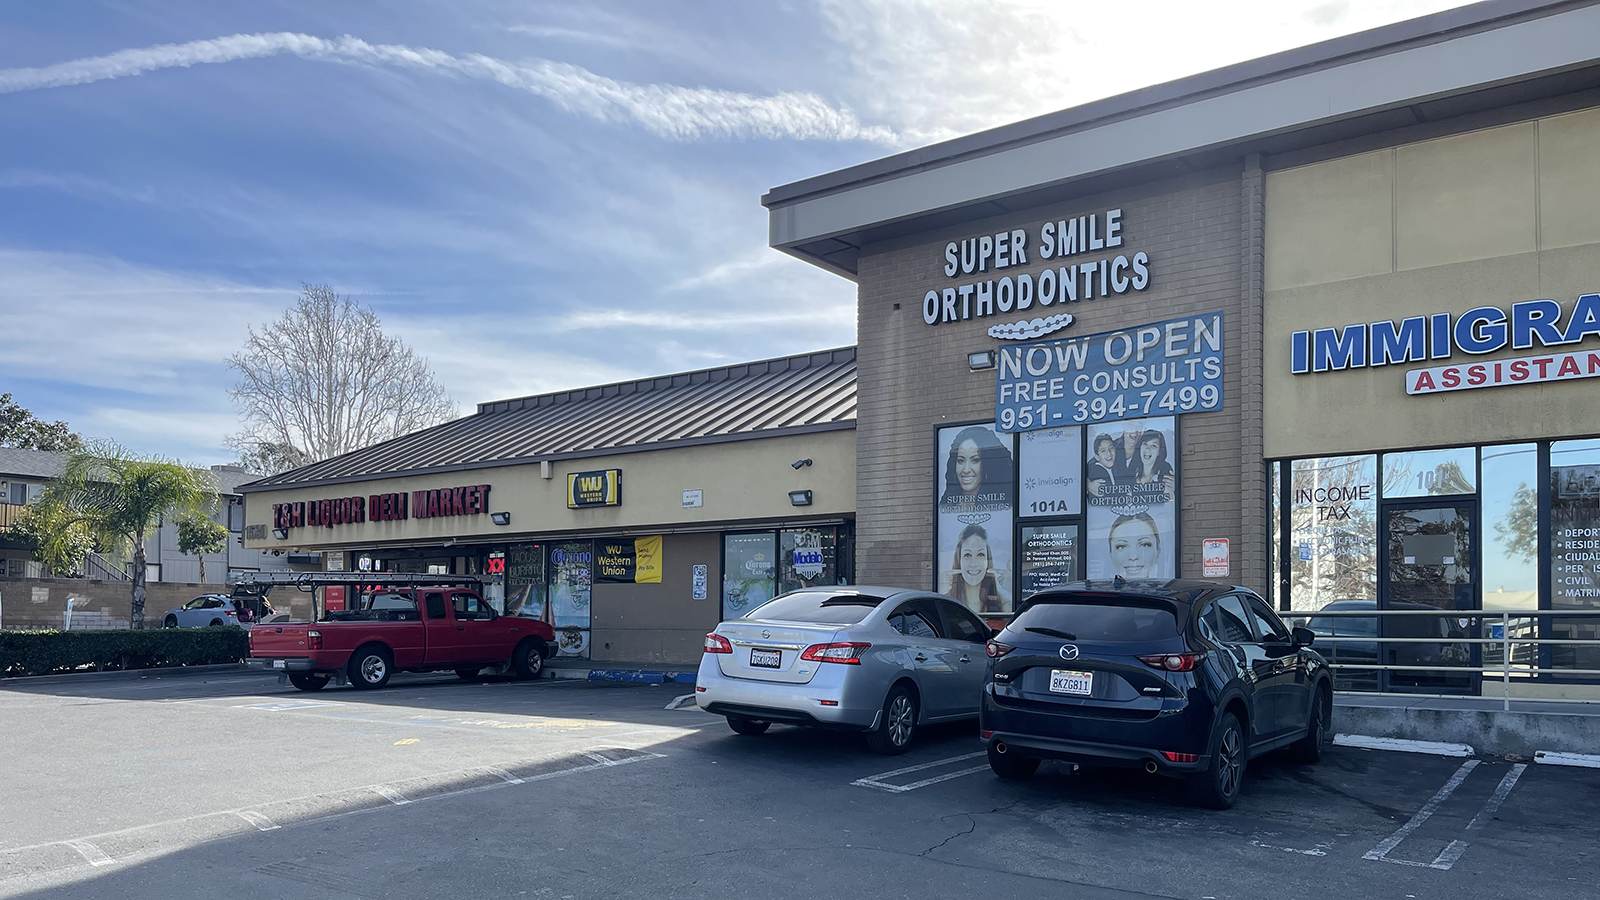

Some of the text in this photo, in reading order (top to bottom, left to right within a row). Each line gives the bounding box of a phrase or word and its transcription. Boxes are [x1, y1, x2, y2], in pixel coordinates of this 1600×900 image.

[944, 208, 1123, 278] SUPER SMILE
[923, 251, 1149, 325] ORTHODONTICS
[1291, 292, 1600, 374] IMMIGRA
[999, 315, 1221, 380] NOW OPEN
[1000, 356, 1222, 405] FREE CONSULTS
[1001, 384, 1220, 431] 951- 394-7499
[577, 476, 602, 491] WU
[1038, 476, 1073, 486] invisalign
[1099, 482, 1165, 494] SUPER SMILE
[1296, 485, 1370, 503] INCOME
[947, 492, 1005, 504] SUPER SMILE
[1091, 493, 1170, 506] ORTHODONTICS
[272, 484, 491, 528] T&H LIQUOR DELI MARKET
[940, 503, 1010, 514] ORTHODONTICS
[1030, 500, 1068, 513] 101A
[1316, 505, 1351, 520] TAX
[1565, 540, 1600, 549] RESIDE
[598, 556, 631, 565] Western
[793, 551, 823, 564] Modelo
[602, 565, 626, 575] Union
[1565, 576, 1590, 585] CIVIL
[1053, 678, 1088, 691] 8KZG811
